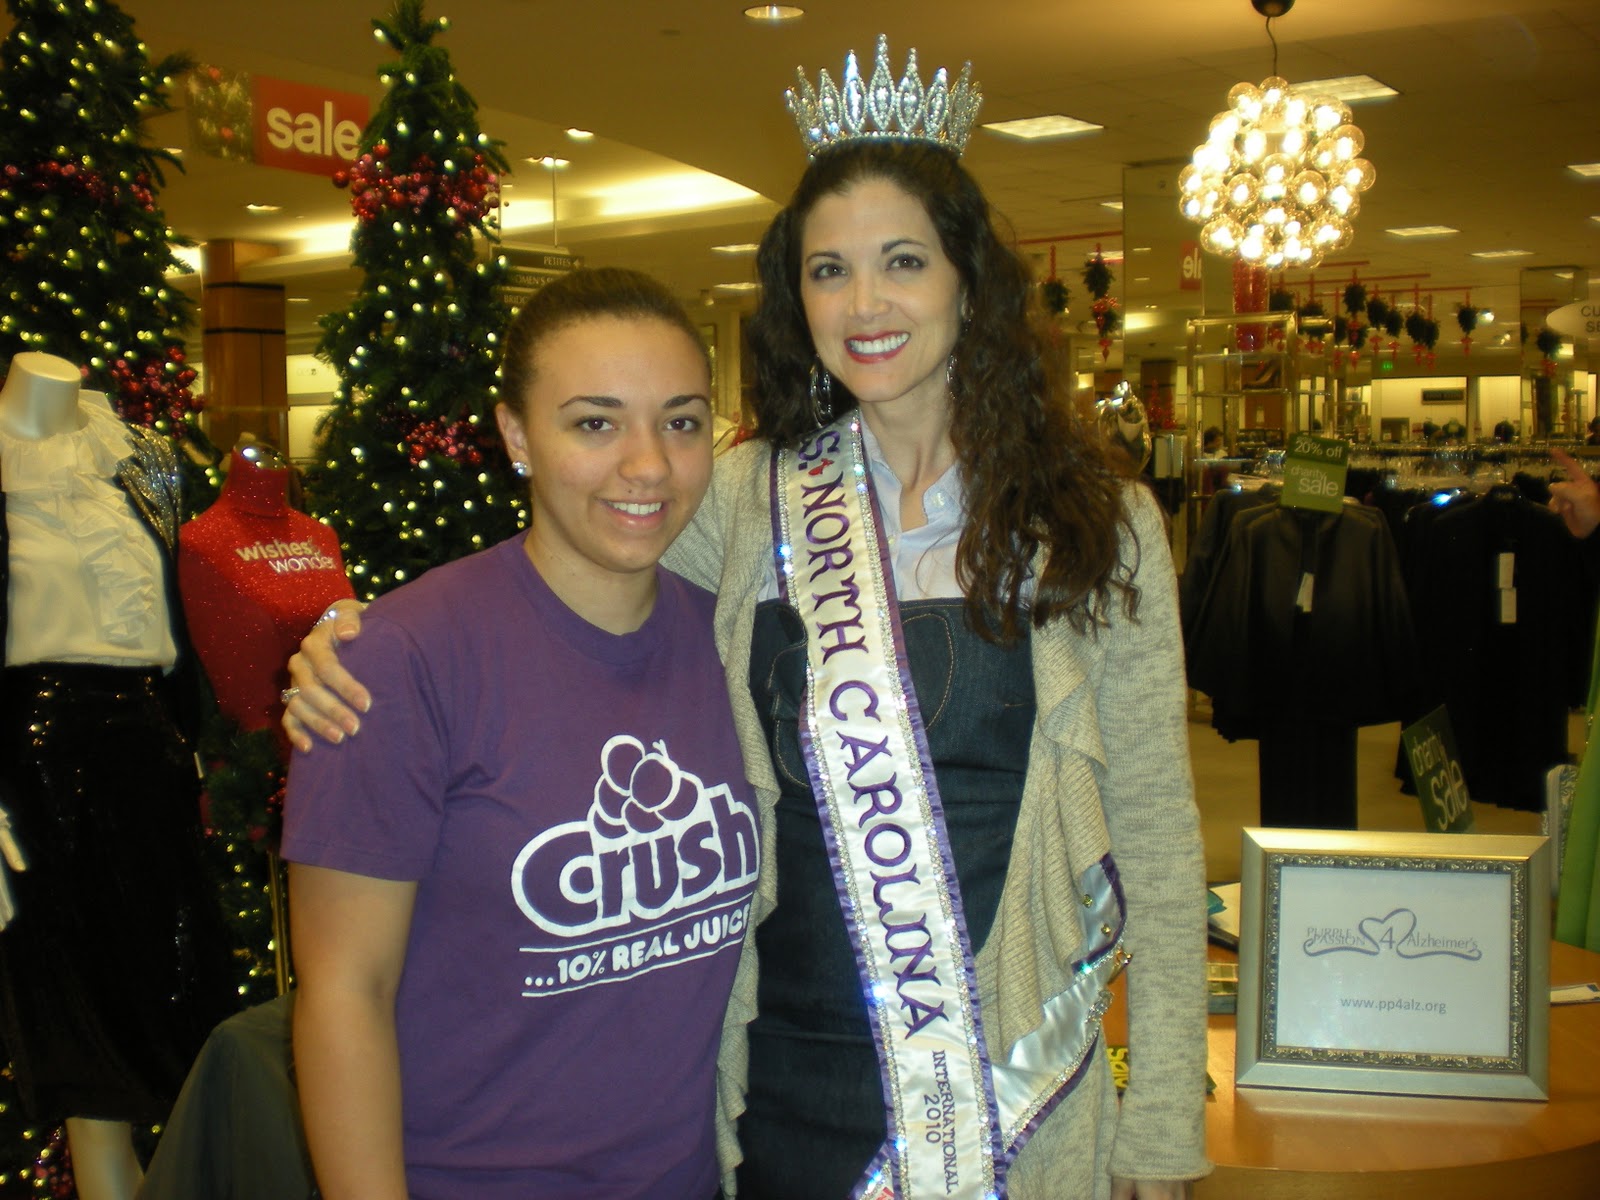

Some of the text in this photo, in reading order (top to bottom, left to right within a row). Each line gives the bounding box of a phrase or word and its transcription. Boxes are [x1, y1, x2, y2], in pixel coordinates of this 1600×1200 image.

[266, 100, 361, 160] sale
[543, 256, 571, 267] PETITES
[1294, 440, 1343, 458] 20% off
[1290, 464, 1327, 480] charity
[1298, 475, 1339, 497] sale
[235, 539, 313, 561] wishes
[268, 552, 337, 573] wonder
[801, 470, 870, 666] NORTH
[1431, 752, 1467, 830] sale
[511, 782, 760, 938] Crush
[829, 679, 949, 1040] CAROLINA
[611, 931, 681, 972] REAL
[1379, 926, 1396, 949] 4
[1406, 931, 1478, 950] Alzheimer's
[1340, 998, 1447, 1014] www.pp4alz.org
[923, 1094, 942, 1144] 2010
[932, 1049, 960, 1195] INTERNATIONAL
